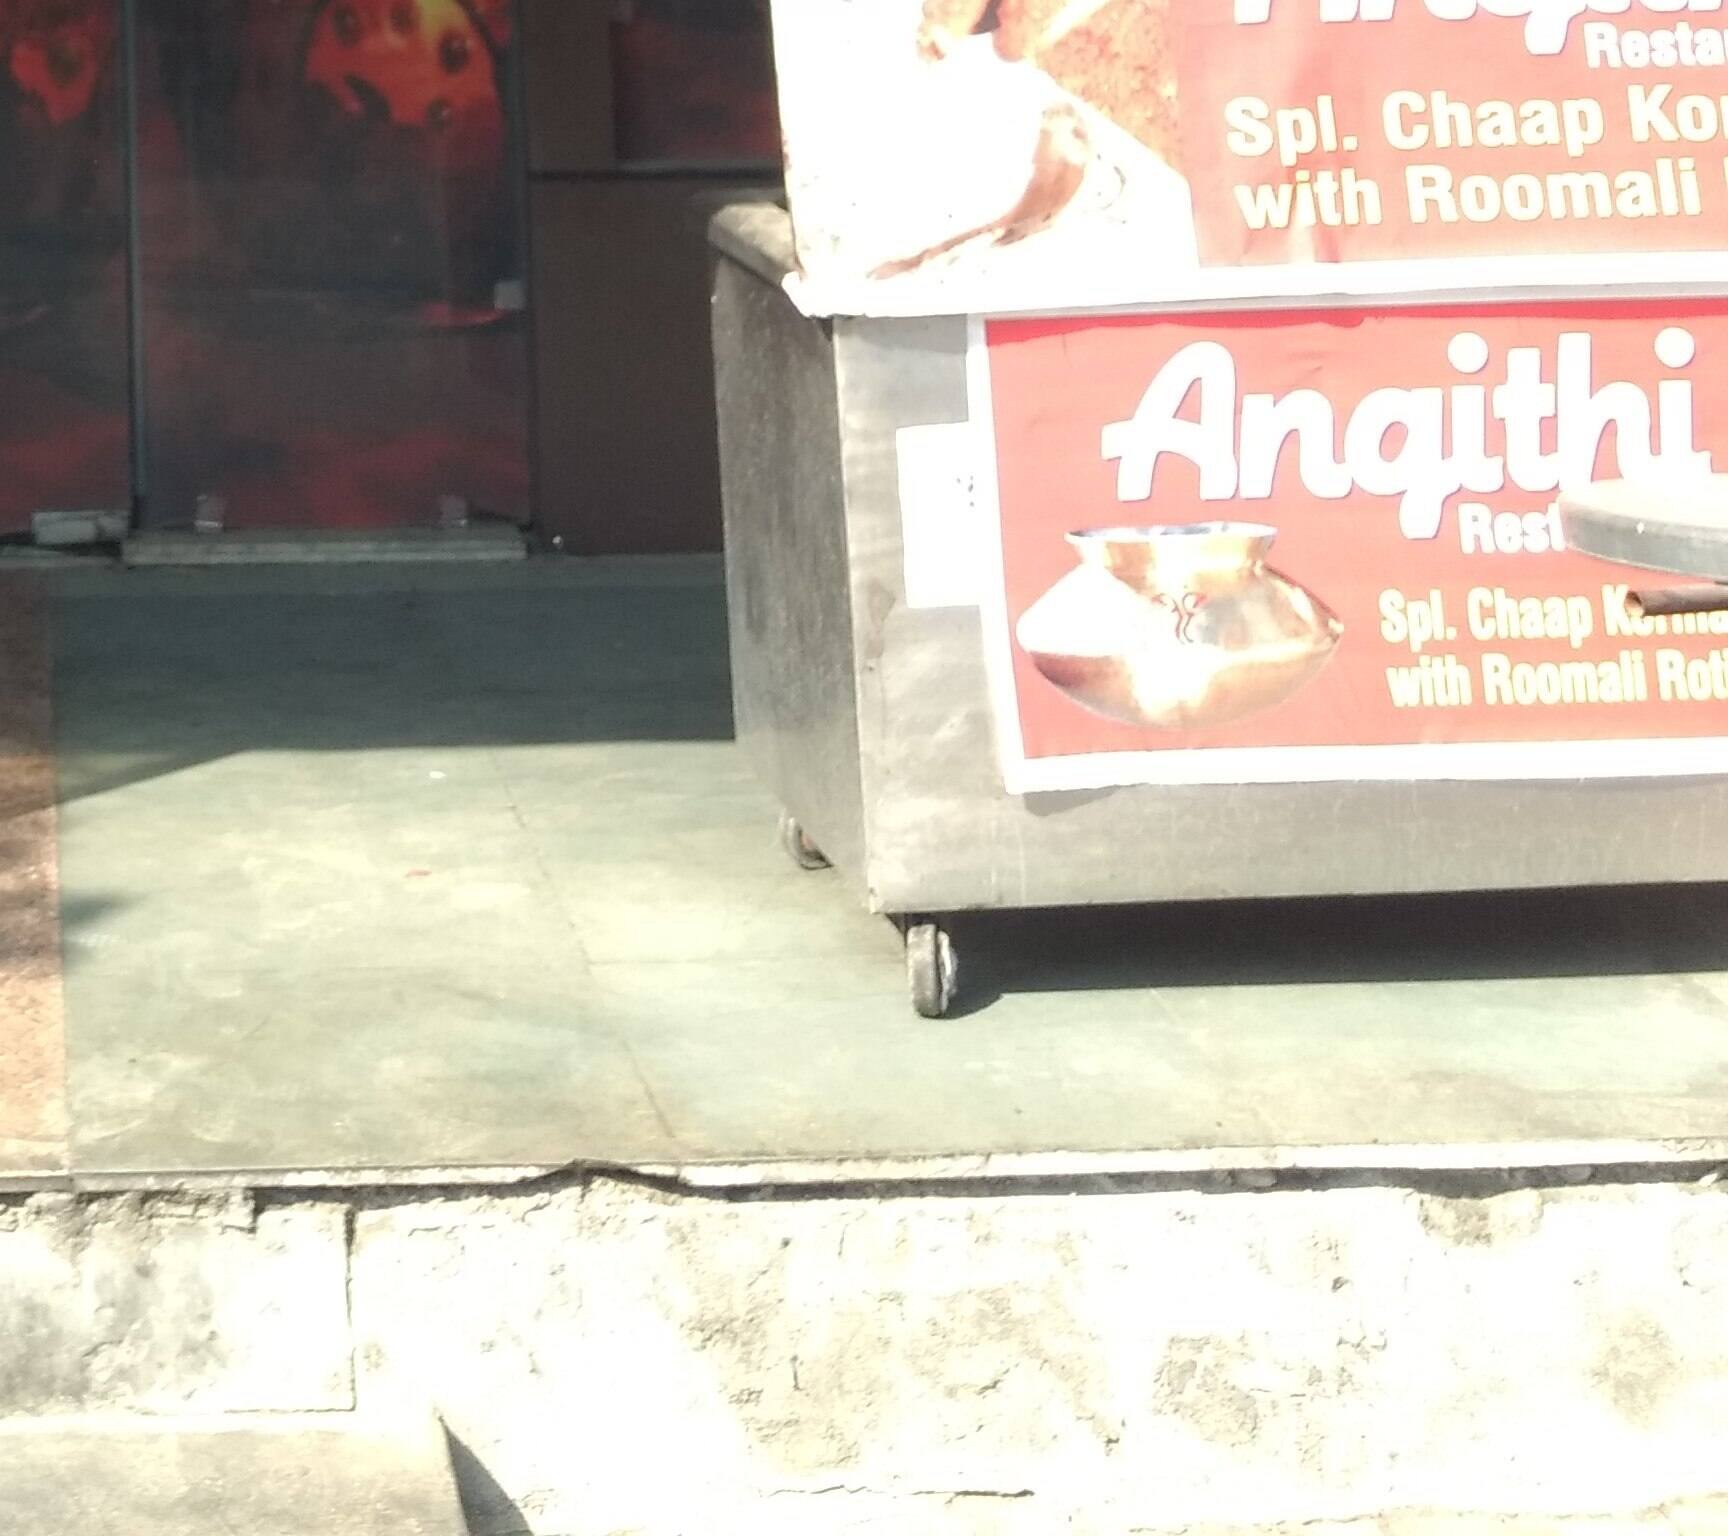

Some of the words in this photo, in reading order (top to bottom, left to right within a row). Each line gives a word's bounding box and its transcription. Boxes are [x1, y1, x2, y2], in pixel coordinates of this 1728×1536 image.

[1583, 20, 1728, 69] Resta
[1224, 94, 1359, 166] Spl.
[1382, 90, 1605, 157] Chaap
[1235, 167, 1383, 230] with
[1405, 157, 1703, 225] Roomali
[1378, 587, 1458, 644] Spl.
[1466, 586, 1593, 649] Chaap
[1386, 654, 1472, 708] with
[1480, 648, 1648, 706] Roomali
